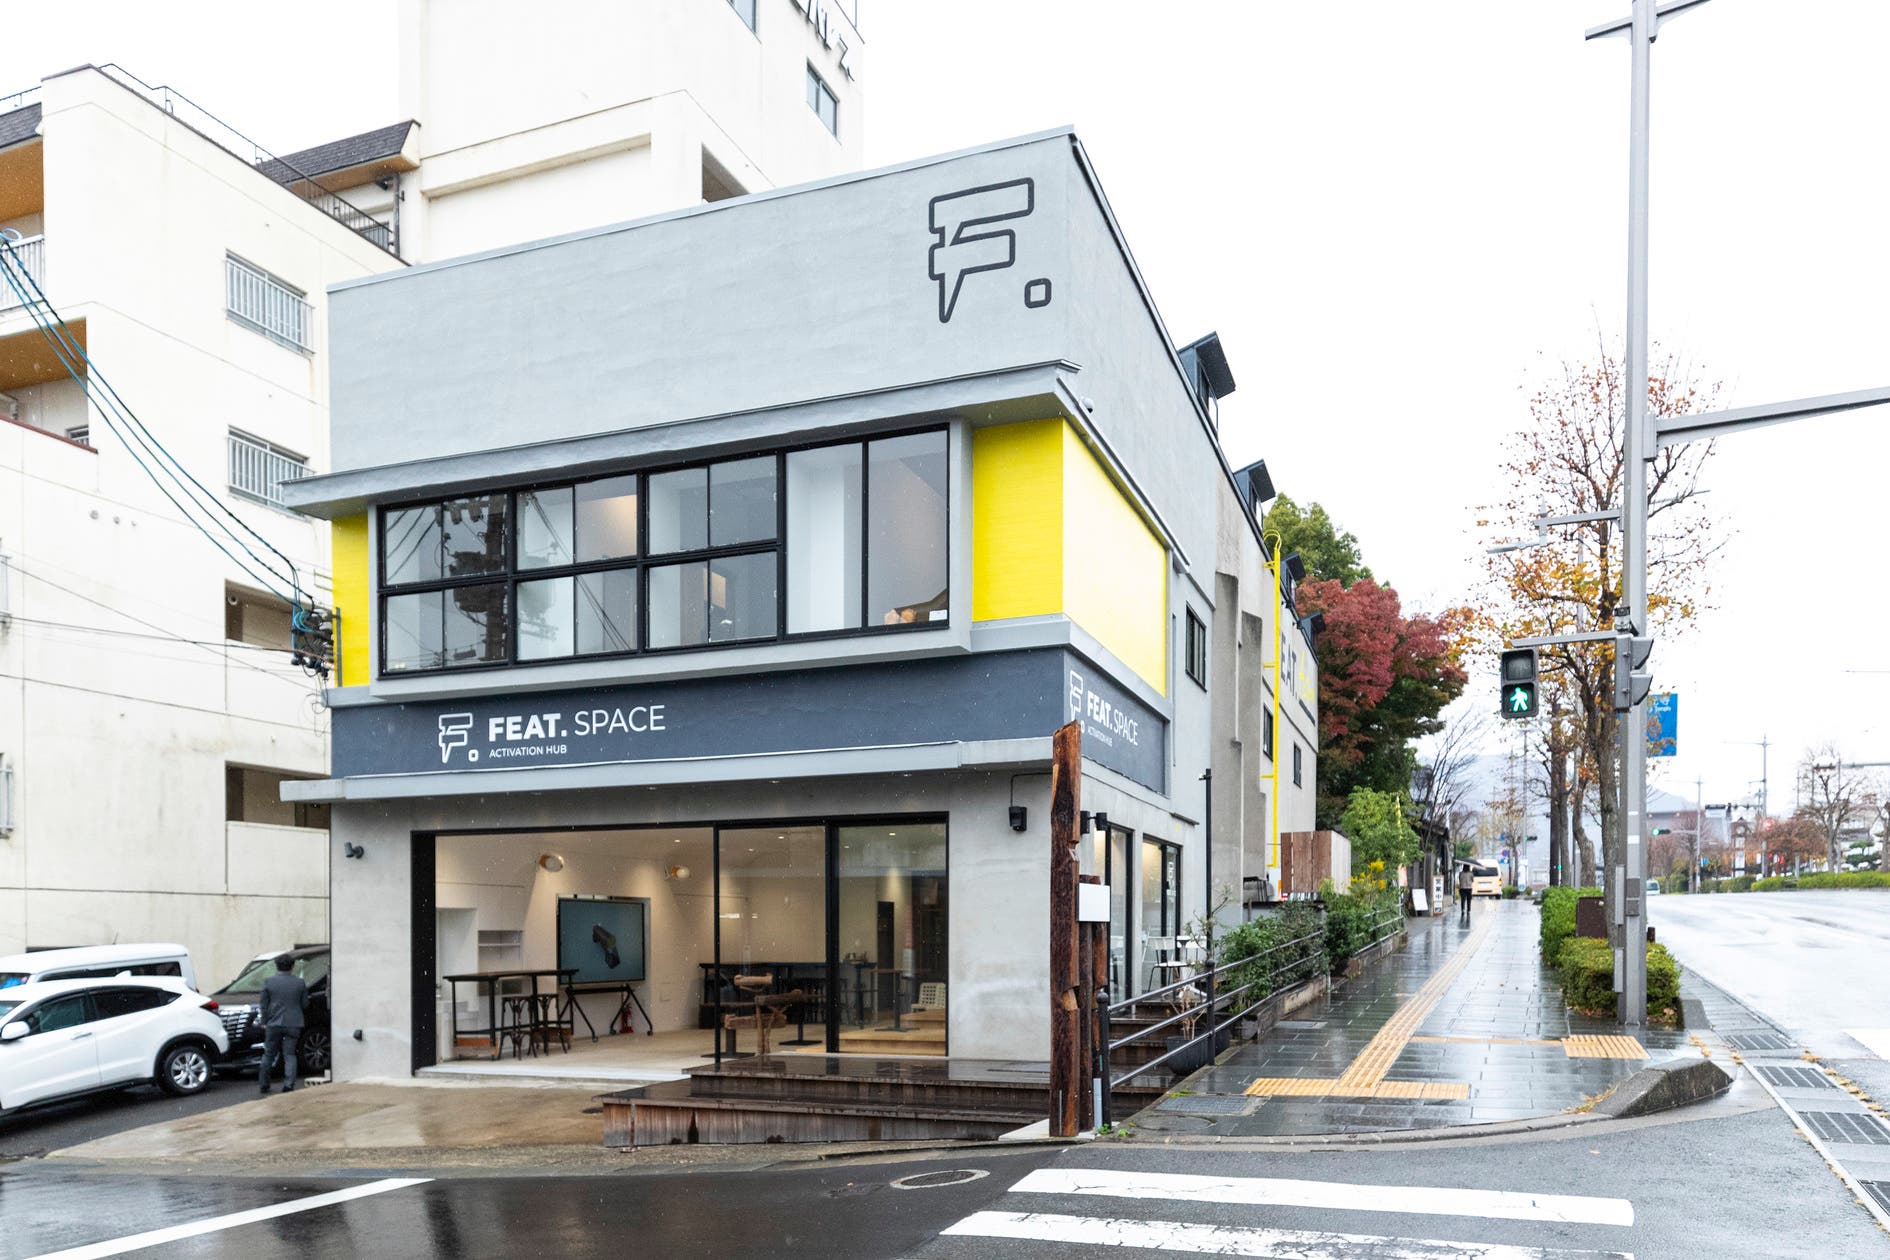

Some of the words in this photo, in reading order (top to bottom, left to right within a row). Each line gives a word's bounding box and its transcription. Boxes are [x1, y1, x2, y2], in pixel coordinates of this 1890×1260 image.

[488, 713, 568, 742] FEAT.
[574, 704, 666, 736] SPACE
[1087, 690, 1112, 730] FEAT.
[1113, 708, 1138, 746] SPACE
[488, 745, 544, 759] ACTIVATION
[546, 744, 568, 755] HUB
